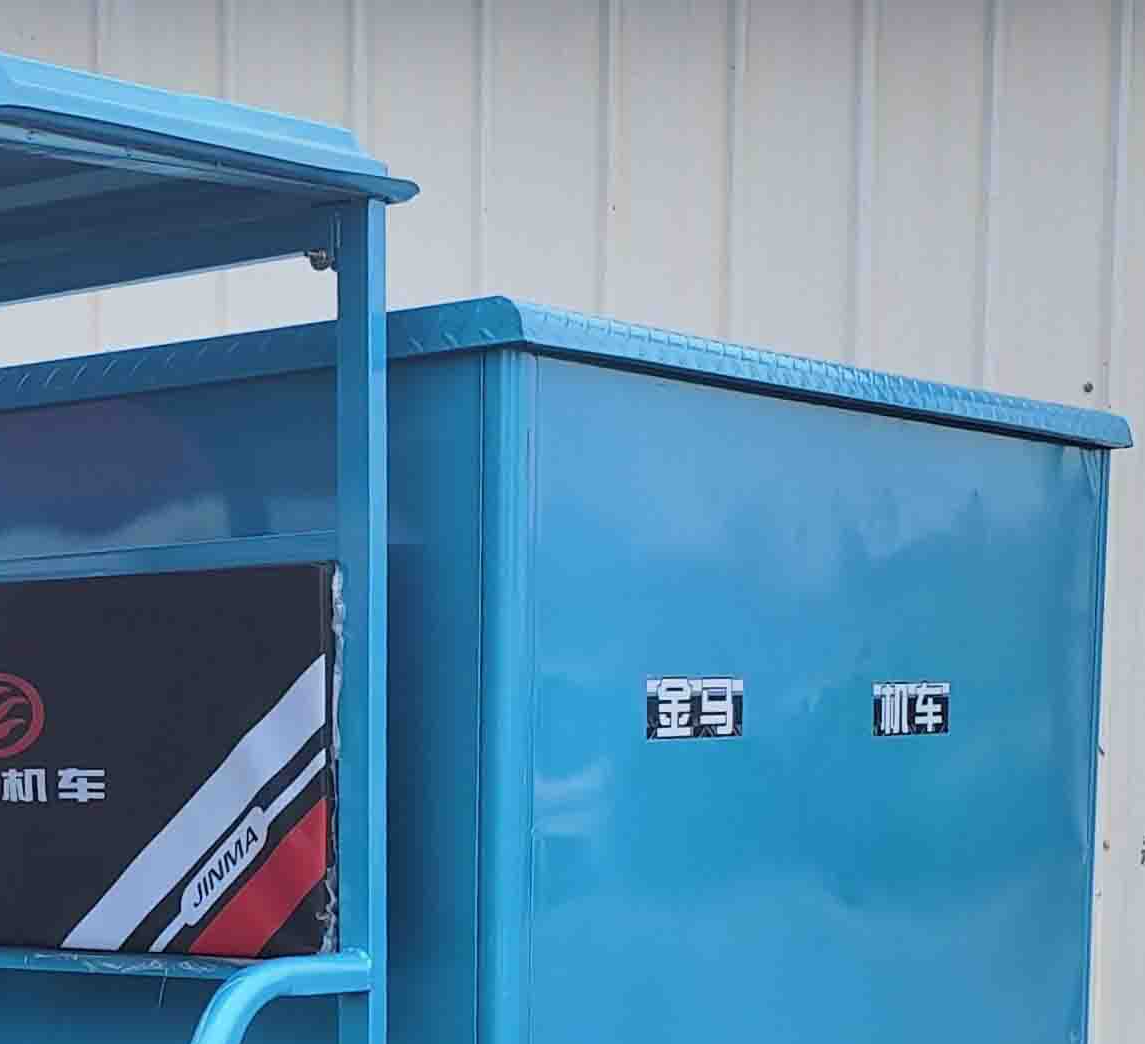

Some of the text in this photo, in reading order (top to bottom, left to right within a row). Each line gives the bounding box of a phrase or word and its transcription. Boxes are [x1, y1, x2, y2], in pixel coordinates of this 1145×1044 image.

[655, 677, 947, 738] 金马 机车
[193, 825, 259, 908] JINMA
